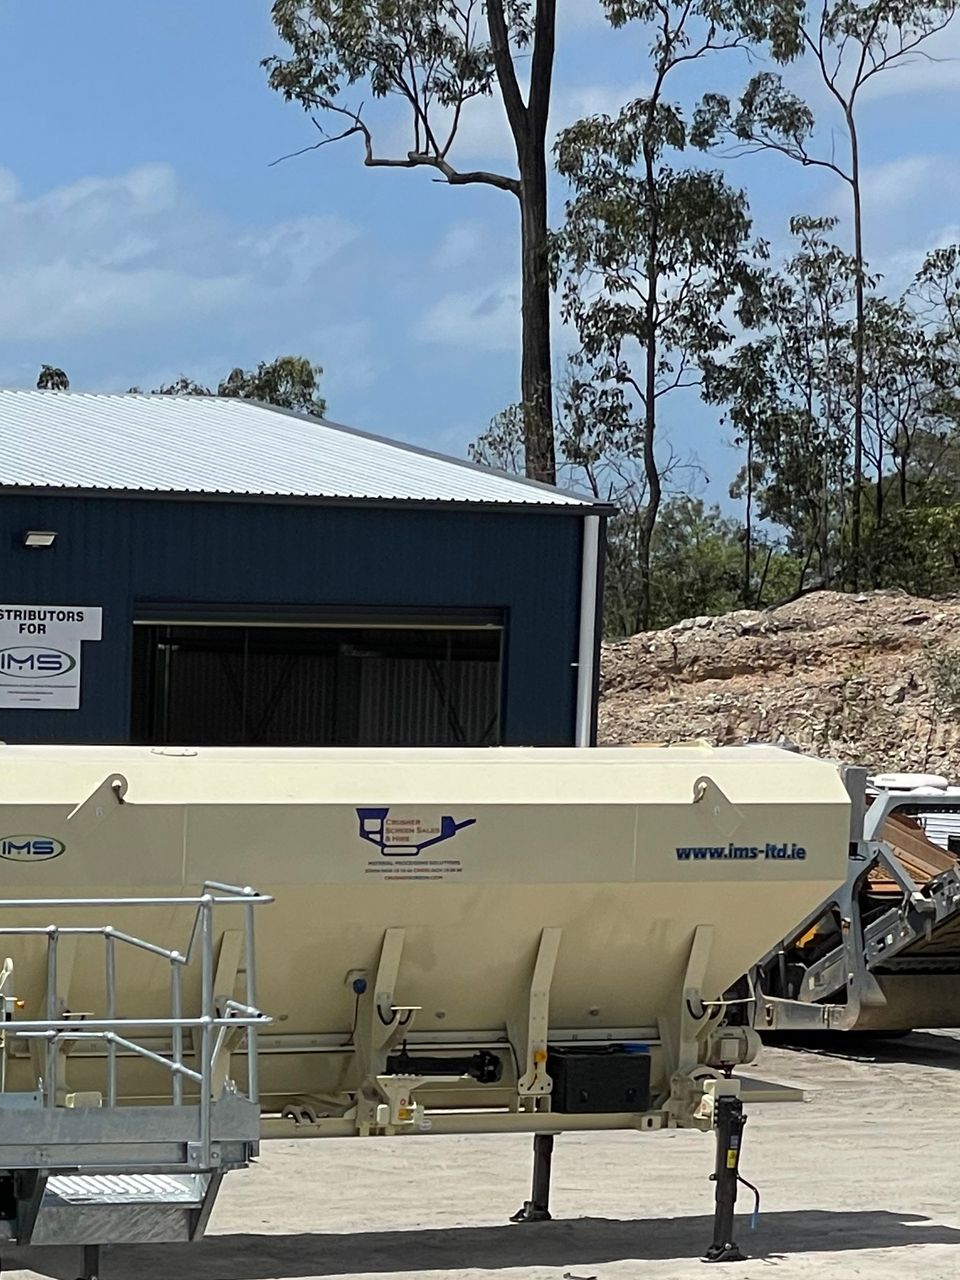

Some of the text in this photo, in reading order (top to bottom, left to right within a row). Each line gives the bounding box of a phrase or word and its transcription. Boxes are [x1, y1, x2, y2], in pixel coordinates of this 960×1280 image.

[19, 623, 46, 634] FOR
[0, 653, 62, 671] IMS
[2, 841, 54, 855] IMS
[676, 843, 806, 860] www.ims-ltd.ie
